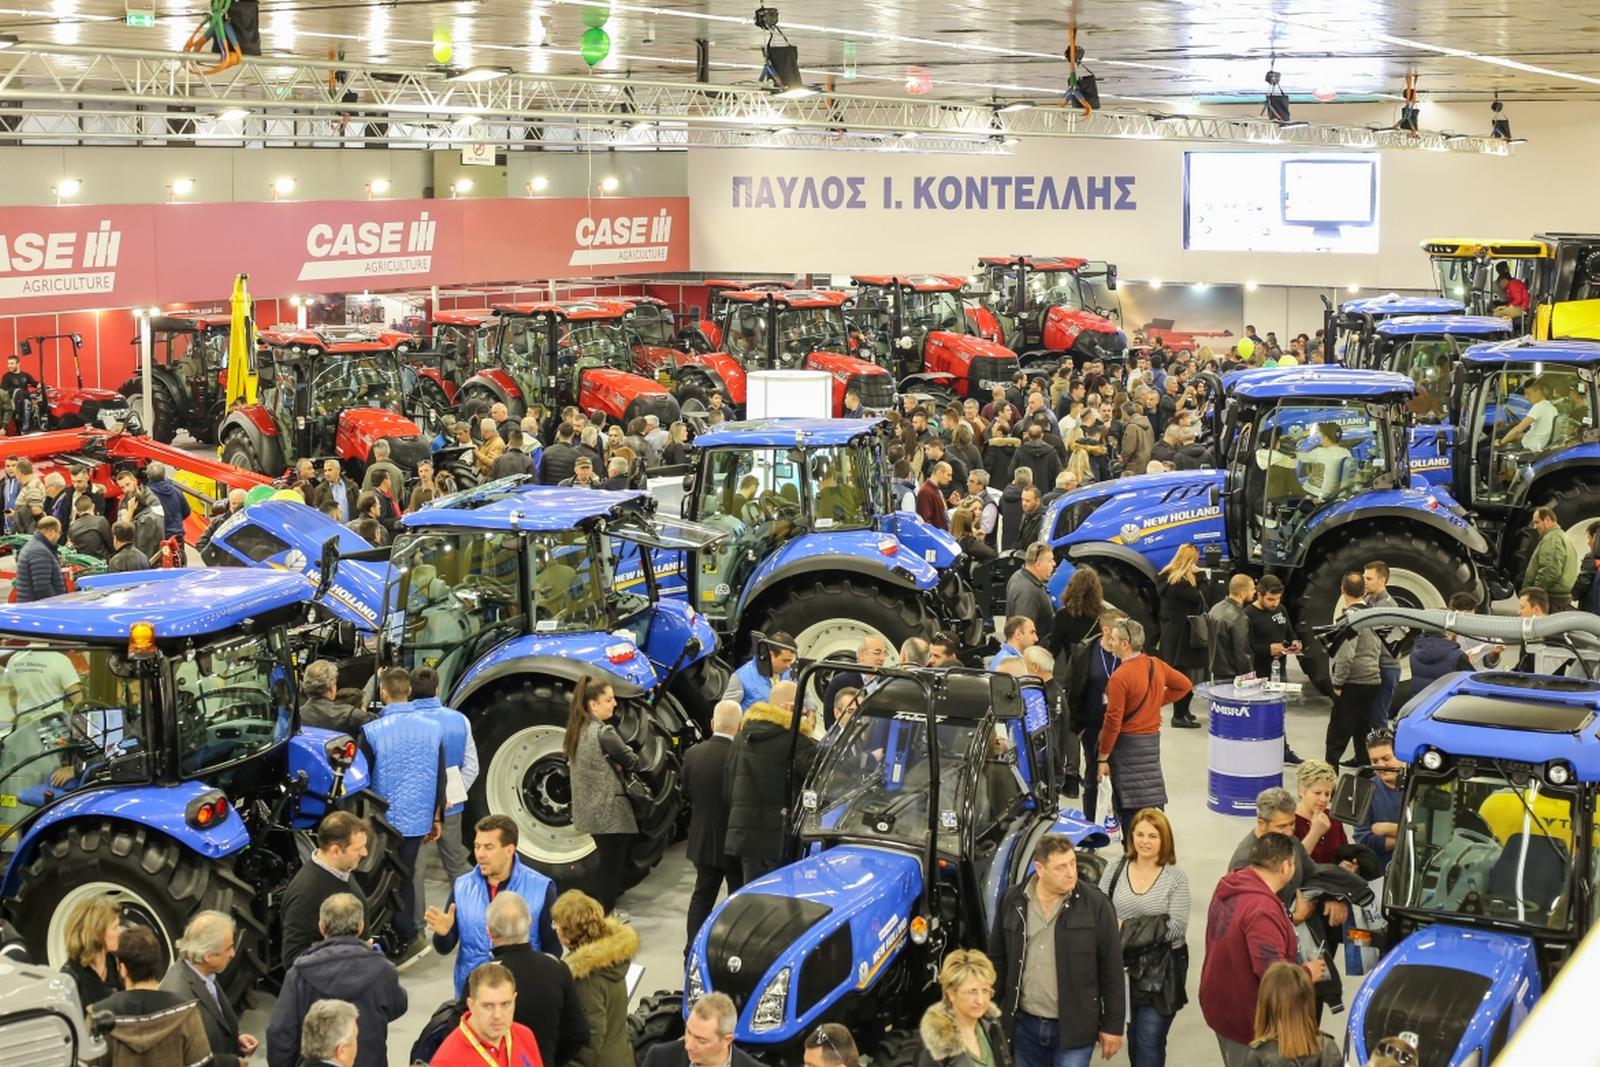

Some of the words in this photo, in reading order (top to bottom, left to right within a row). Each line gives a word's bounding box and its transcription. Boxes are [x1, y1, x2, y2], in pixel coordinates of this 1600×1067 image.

[732, 176, 866, 210] ΠΑΥΛΟΣ
[913, 176, 1137, 210] ΚΟΝΤΕΛΛΗΣ
[306, 222, 405, 258] CASE
[575, 216, 649, 247] CASE
[364, 259, 428, 273] AGRICULTURE
[22, 276, 110, 293] AGRICULTURE
[1410, 457, 1450, 468] OLLAND
[1143, 515, 1168, 528] NEW
[1169, 505, 1220, 522] HOLLAND
[330, 584, 378, 621] HOLLAND
[1210, 701, 1250, 718] AMBRA
